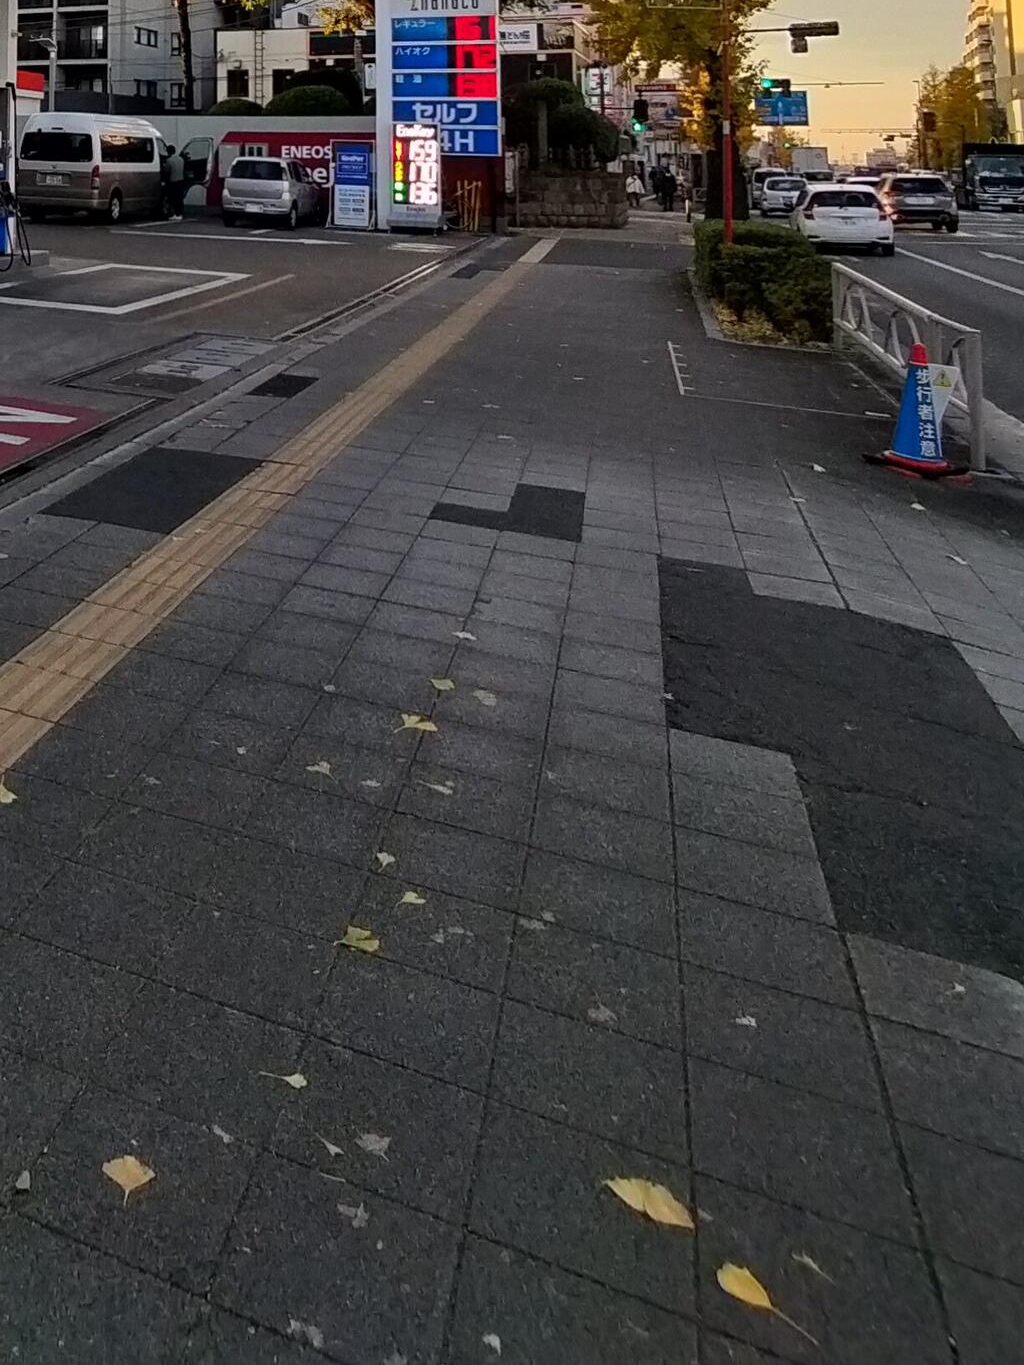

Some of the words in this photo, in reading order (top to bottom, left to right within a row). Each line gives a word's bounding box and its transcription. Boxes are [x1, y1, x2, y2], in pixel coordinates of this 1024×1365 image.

[394, 20, 436, 28] レギュラー
[395, 47, 431, 56] ハイオク
[412, 102, 477, 124] セルフ
[281, 145, 333, 159] ENEOS
[409, 139, 437, 161] 159
[409, 162, 437, 183] 170
[409, 183, 437, 205] 136
[916, 368, 936, 457] 歩行者注意
